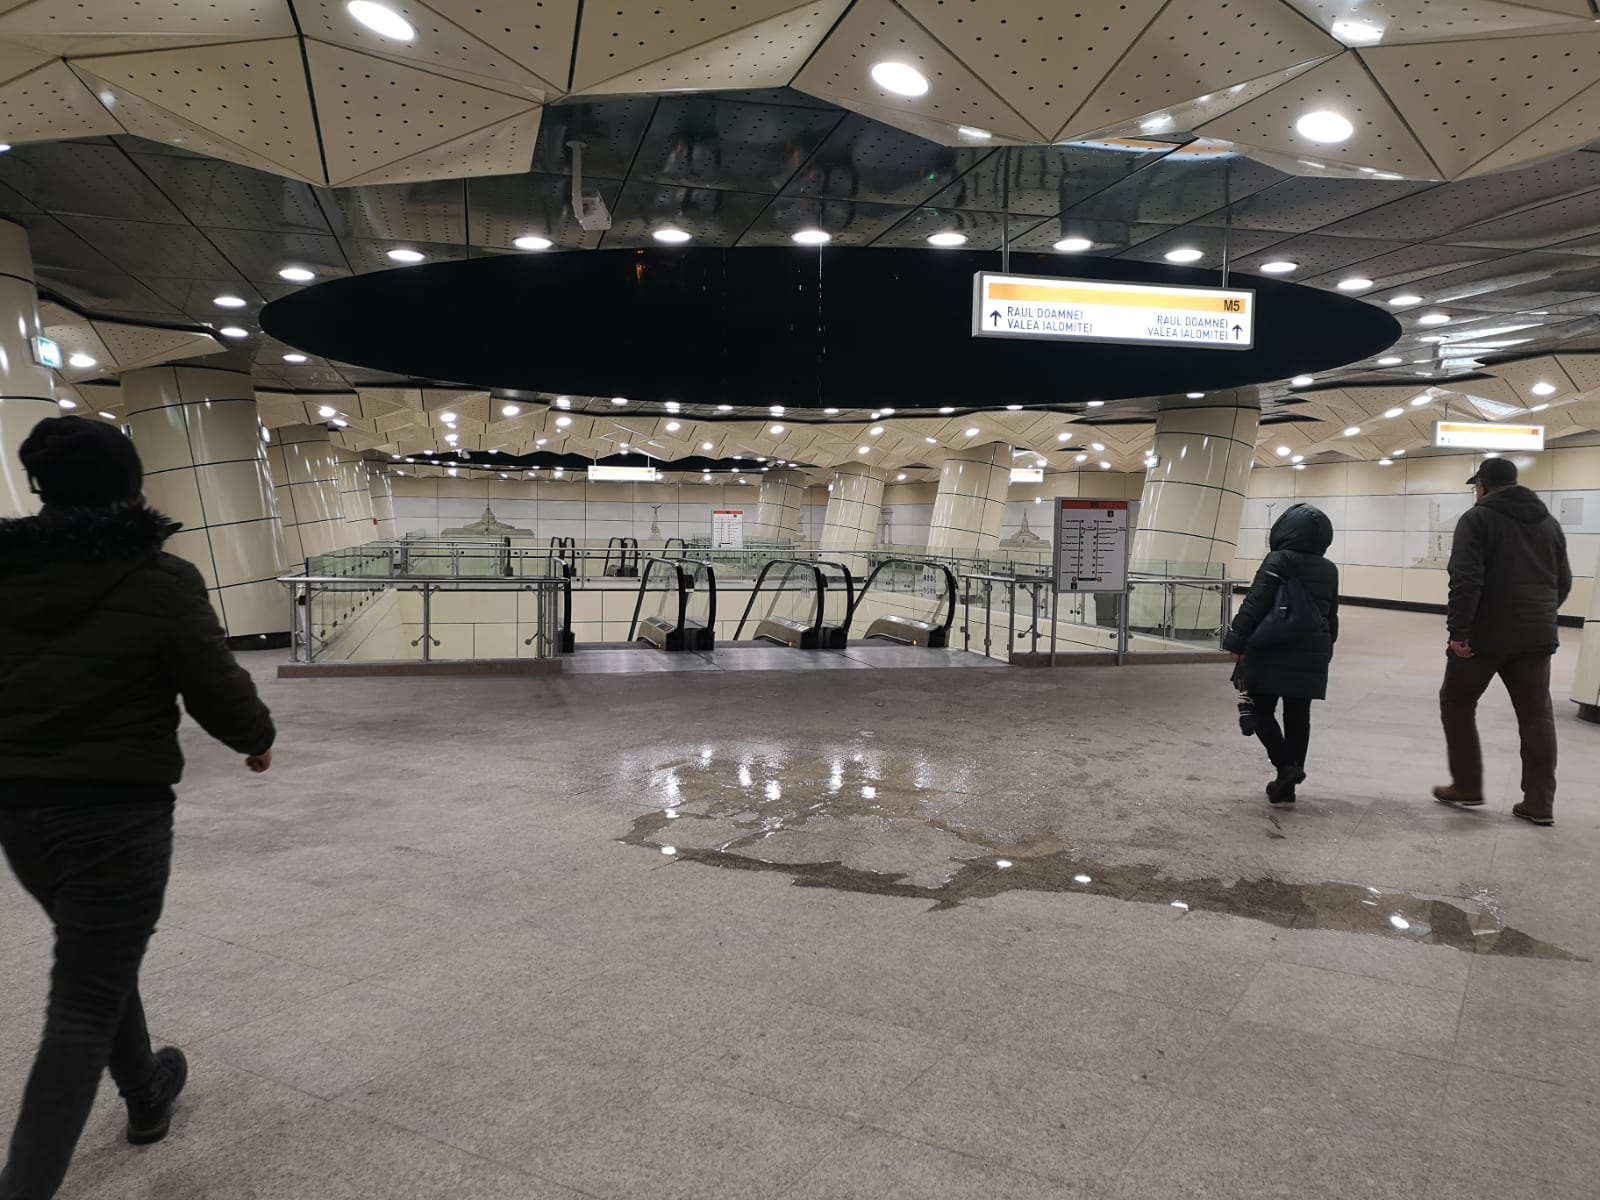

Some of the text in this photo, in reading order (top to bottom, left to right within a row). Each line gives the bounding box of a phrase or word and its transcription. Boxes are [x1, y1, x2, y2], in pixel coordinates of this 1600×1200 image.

[1223, 299, 1241, 312] M5
[1007, 306, 1084, 321] RAUL DOAMNEI
[1007, 318, 1040, 330] VALEA
[1157, 314, 1229, 329] RAUL DOAMNEI
[1147, 327, 1178, 338] VALEA
